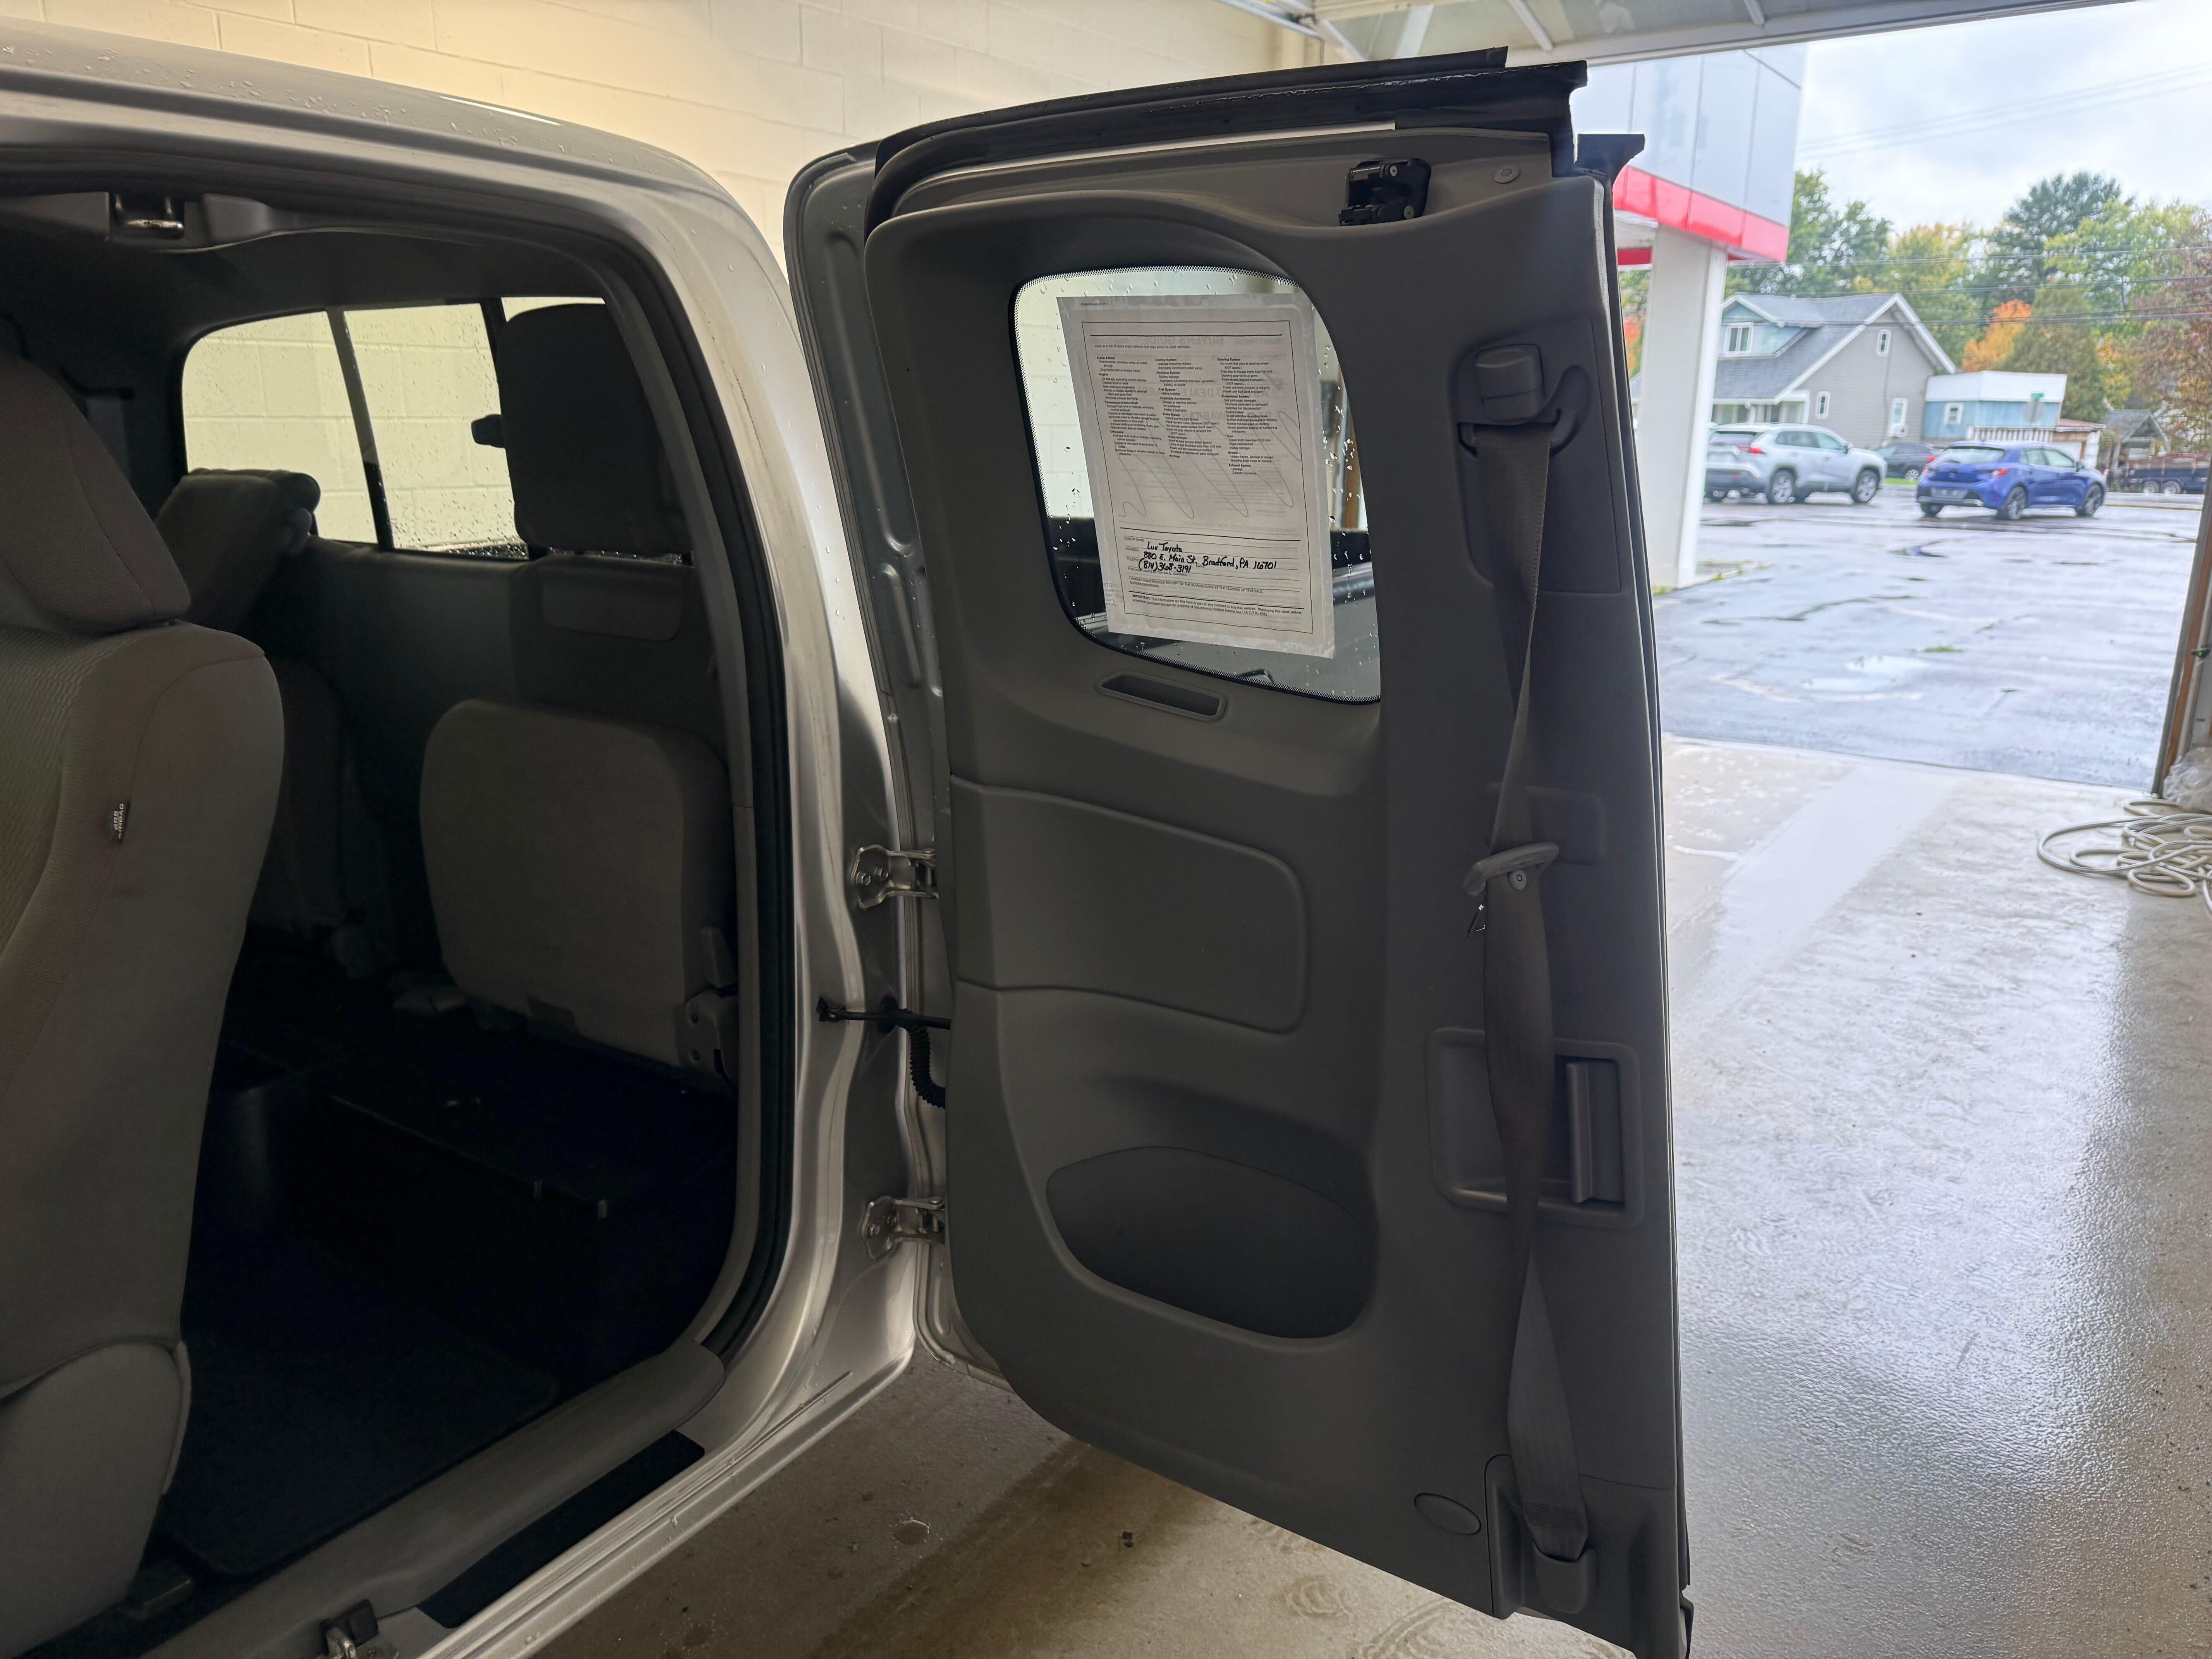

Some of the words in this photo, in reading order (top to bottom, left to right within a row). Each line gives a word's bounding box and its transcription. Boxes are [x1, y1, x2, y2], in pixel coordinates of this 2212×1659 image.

[1147, 541, 1158, 549] Luv
[1158, 542, 1183, 553] Toyota
[1168, 553, 1184, 563] Main
[1186, 555, 1197, 564] St.
[1202, 555, 1238, 569] Bradford,
[1239, 558, 1249, 568] PA
[1253, 561, 1277, 569] 16701
